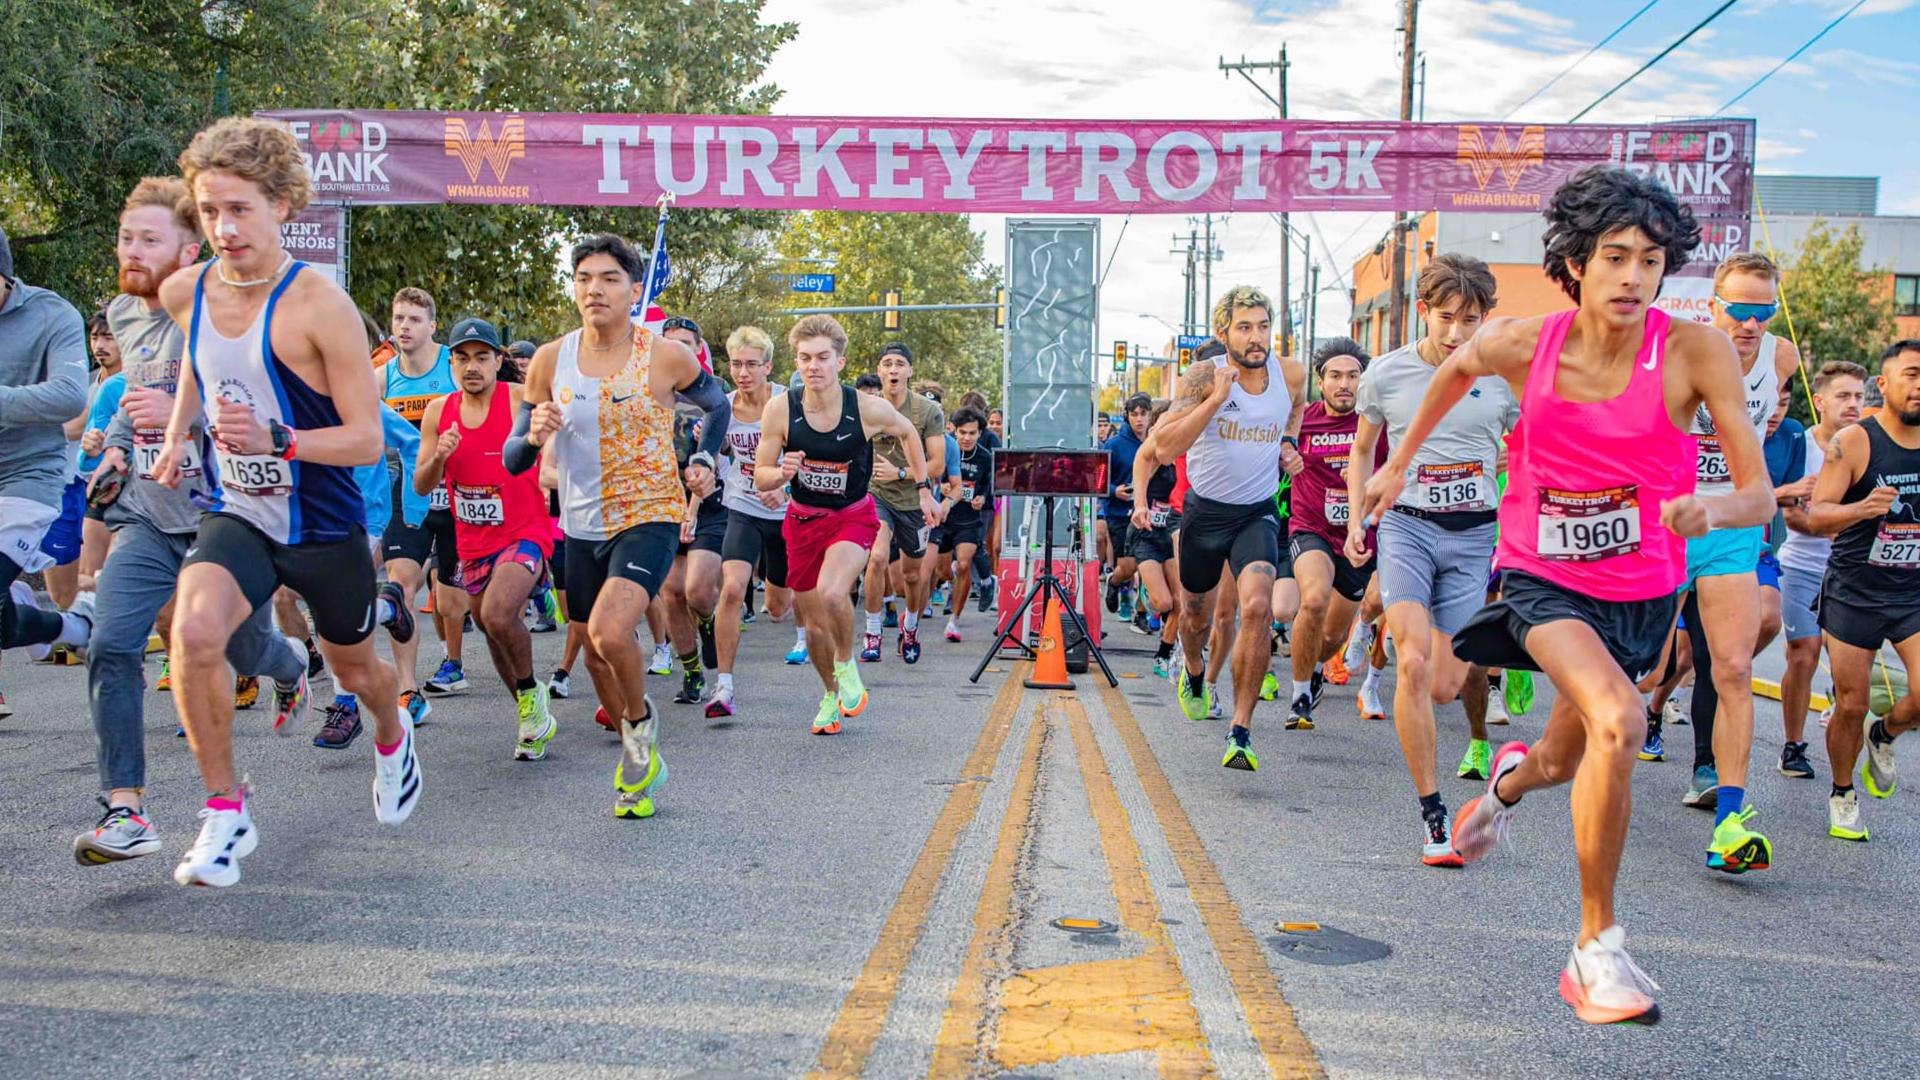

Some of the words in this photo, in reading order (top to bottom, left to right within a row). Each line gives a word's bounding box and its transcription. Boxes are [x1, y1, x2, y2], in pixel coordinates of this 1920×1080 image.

[1308, 139, 1385, 190] 5K
[321, 184, 365, 192] SOUTHWEST
[367, 184, 390, 192] TEXAS
[447, 185, 529, 198] WHATABURGER
[1452, 193, 1541, 206] WHATABURGER
[281, 223, 321, 235] VENT
[1658, 297, 1707, 311] GRAC
[1311, 432, 1357, 447] CÓRRA
[226, 457, 282, 485] 1635
[804, 473, 842, 489] 3339
[1429, 482, 1477, 504] 5136
[461, 502, 498, 519] 1842
[1332, 506, 1349, 519] 26
[1556, 517, 1629, 550] 1960
